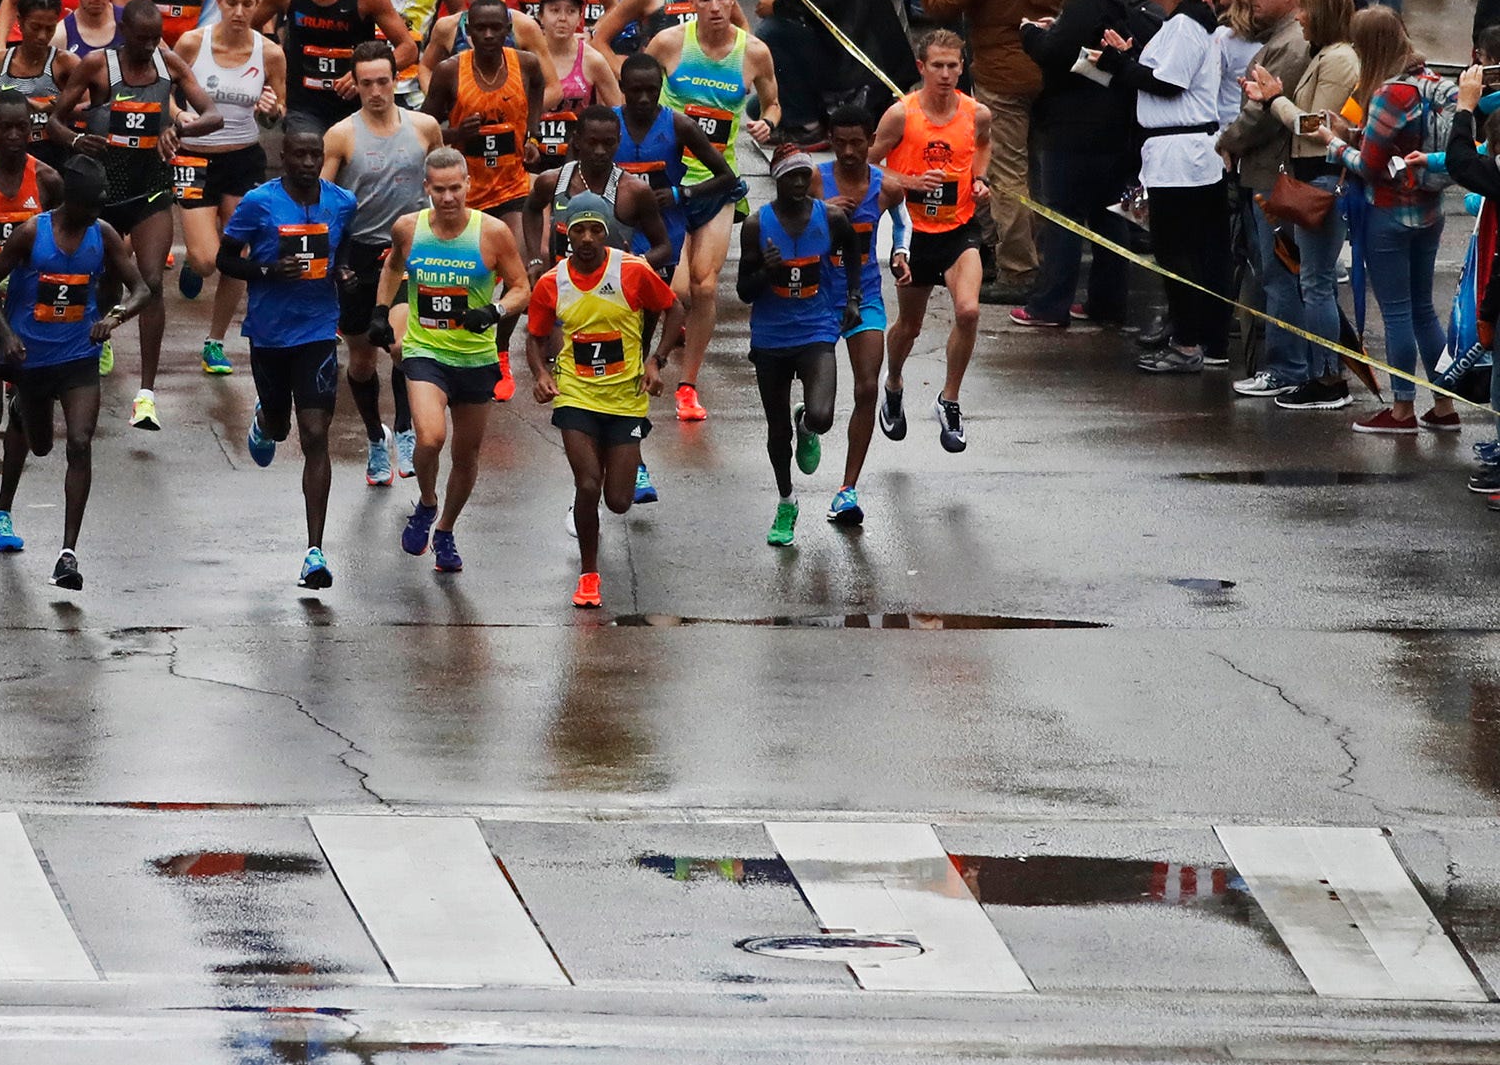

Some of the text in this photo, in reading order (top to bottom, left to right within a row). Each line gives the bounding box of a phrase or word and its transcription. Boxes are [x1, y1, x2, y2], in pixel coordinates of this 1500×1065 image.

[318, 57, 336, 73] 51
[690, 76, 739, 93] BROOKS
[125, 112, 146, 130] 32
[539, 120, 567, 137] 114
[697, 117, 717, 135] 59
[485, 135, 496, 150] 5
[2, 222, 13, 239] 6
[300, 235, 309, 252] 1
[424, 257, 477, 270] BROOKS
[416, 268, 471, 286] Run n Fun
[57, 284, 69, 300] 2
[590, 342, 603, 359] 7
